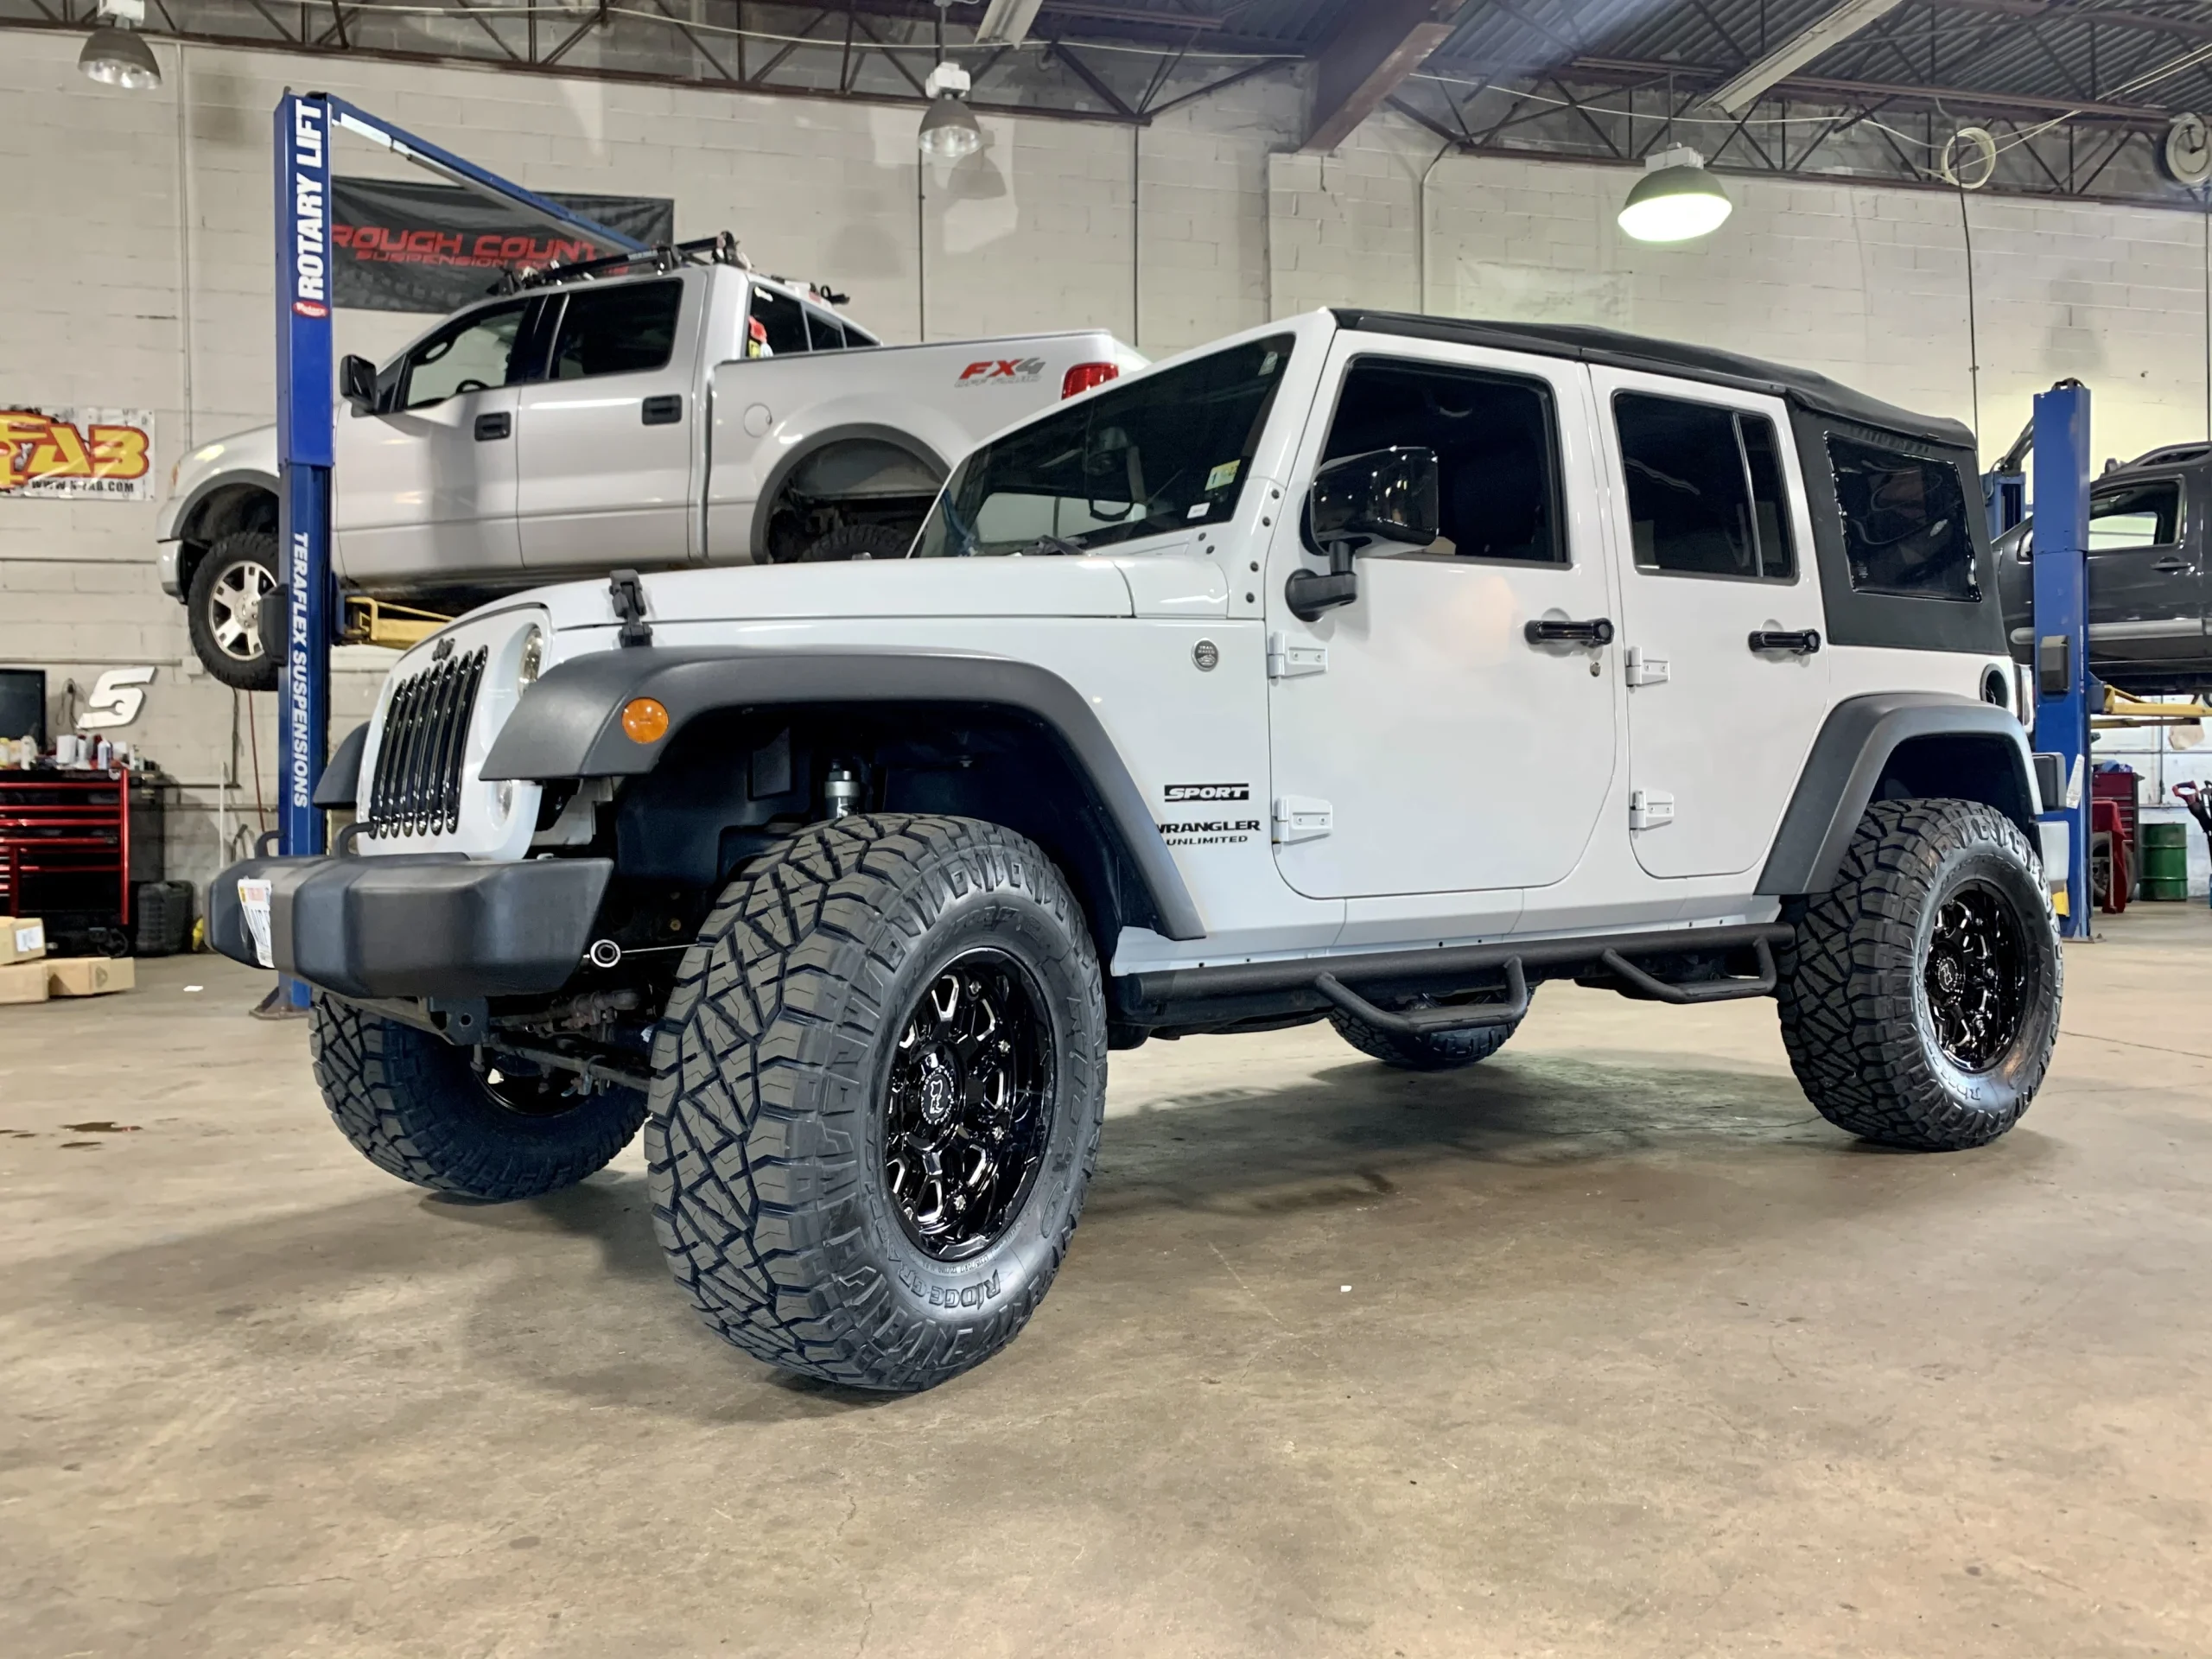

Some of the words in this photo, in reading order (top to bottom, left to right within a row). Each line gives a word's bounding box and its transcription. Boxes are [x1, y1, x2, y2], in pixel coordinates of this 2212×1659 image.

[295, 98, 322, 168] LIFT
[296, 172, 324, 301] ROTARY
[332, 223, 463, 254] ROUGH
[958, 357, 1046, 380] FX4
[292, 531, 308, 647] TERAFLEX
[292, 649, 308, 809] SUSPENSIONS
[1164, 785, 1249, 800] SPORT
[1166, 835, 1249, 846] UNLIMITED
[928, 1268, 1001, 1311] RIDGE
